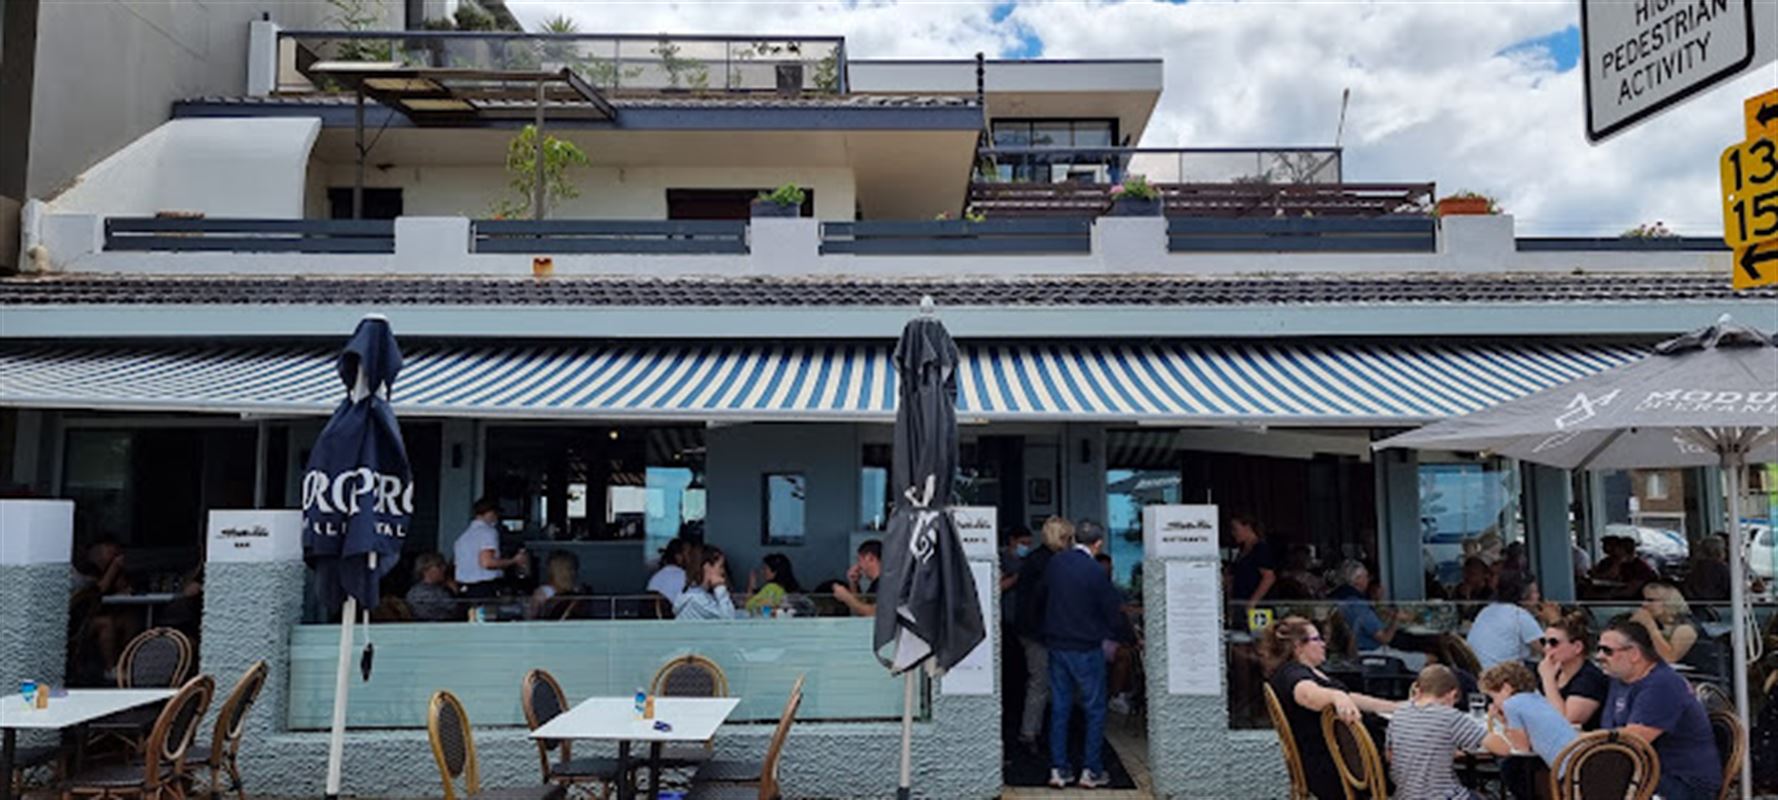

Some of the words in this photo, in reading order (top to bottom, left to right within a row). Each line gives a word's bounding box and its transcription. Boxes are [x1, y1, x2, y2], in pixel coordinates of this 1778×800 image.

[1602, 0, 1728, 79] PEDESTRIAN
[1618, 31, 1711, 105] ACTIVITY
[1729, 137, 1778, 192] 13
[1733, 190, 1778, 241] 15
